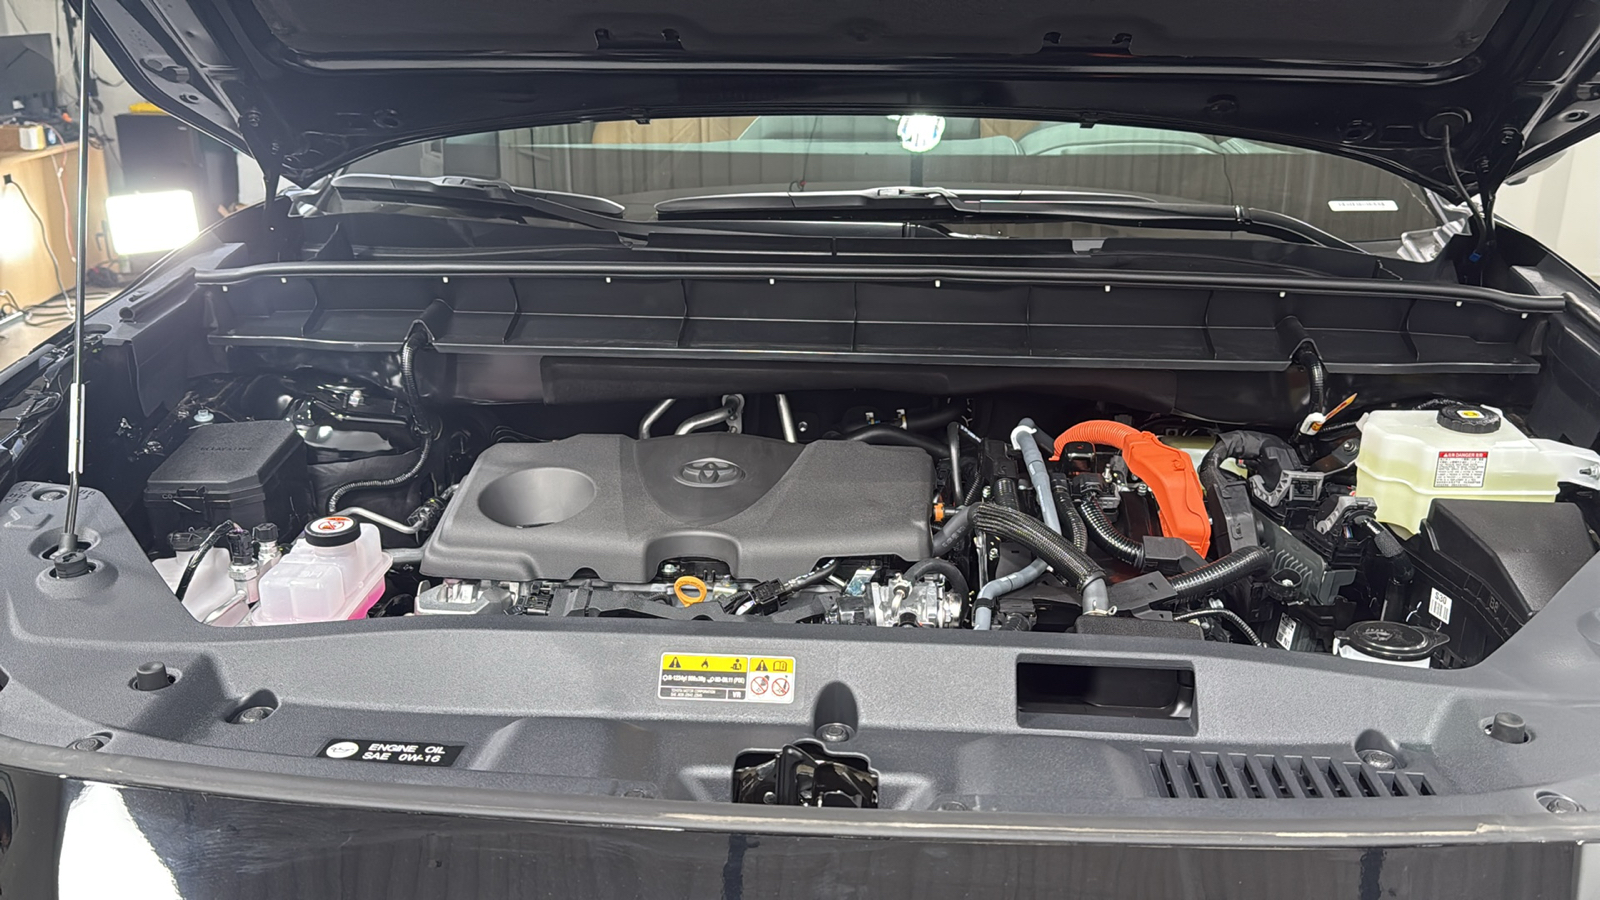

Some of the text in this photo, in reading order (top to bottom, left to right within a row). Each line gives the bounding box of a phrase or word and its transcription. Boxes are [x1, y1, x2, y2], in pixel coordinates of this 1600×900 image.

[1434, 591, 1448, 605] S30
[368, 743, 446, 755] ENGINE OIL
[362, 752, 442, 763] SAE 0W-16
